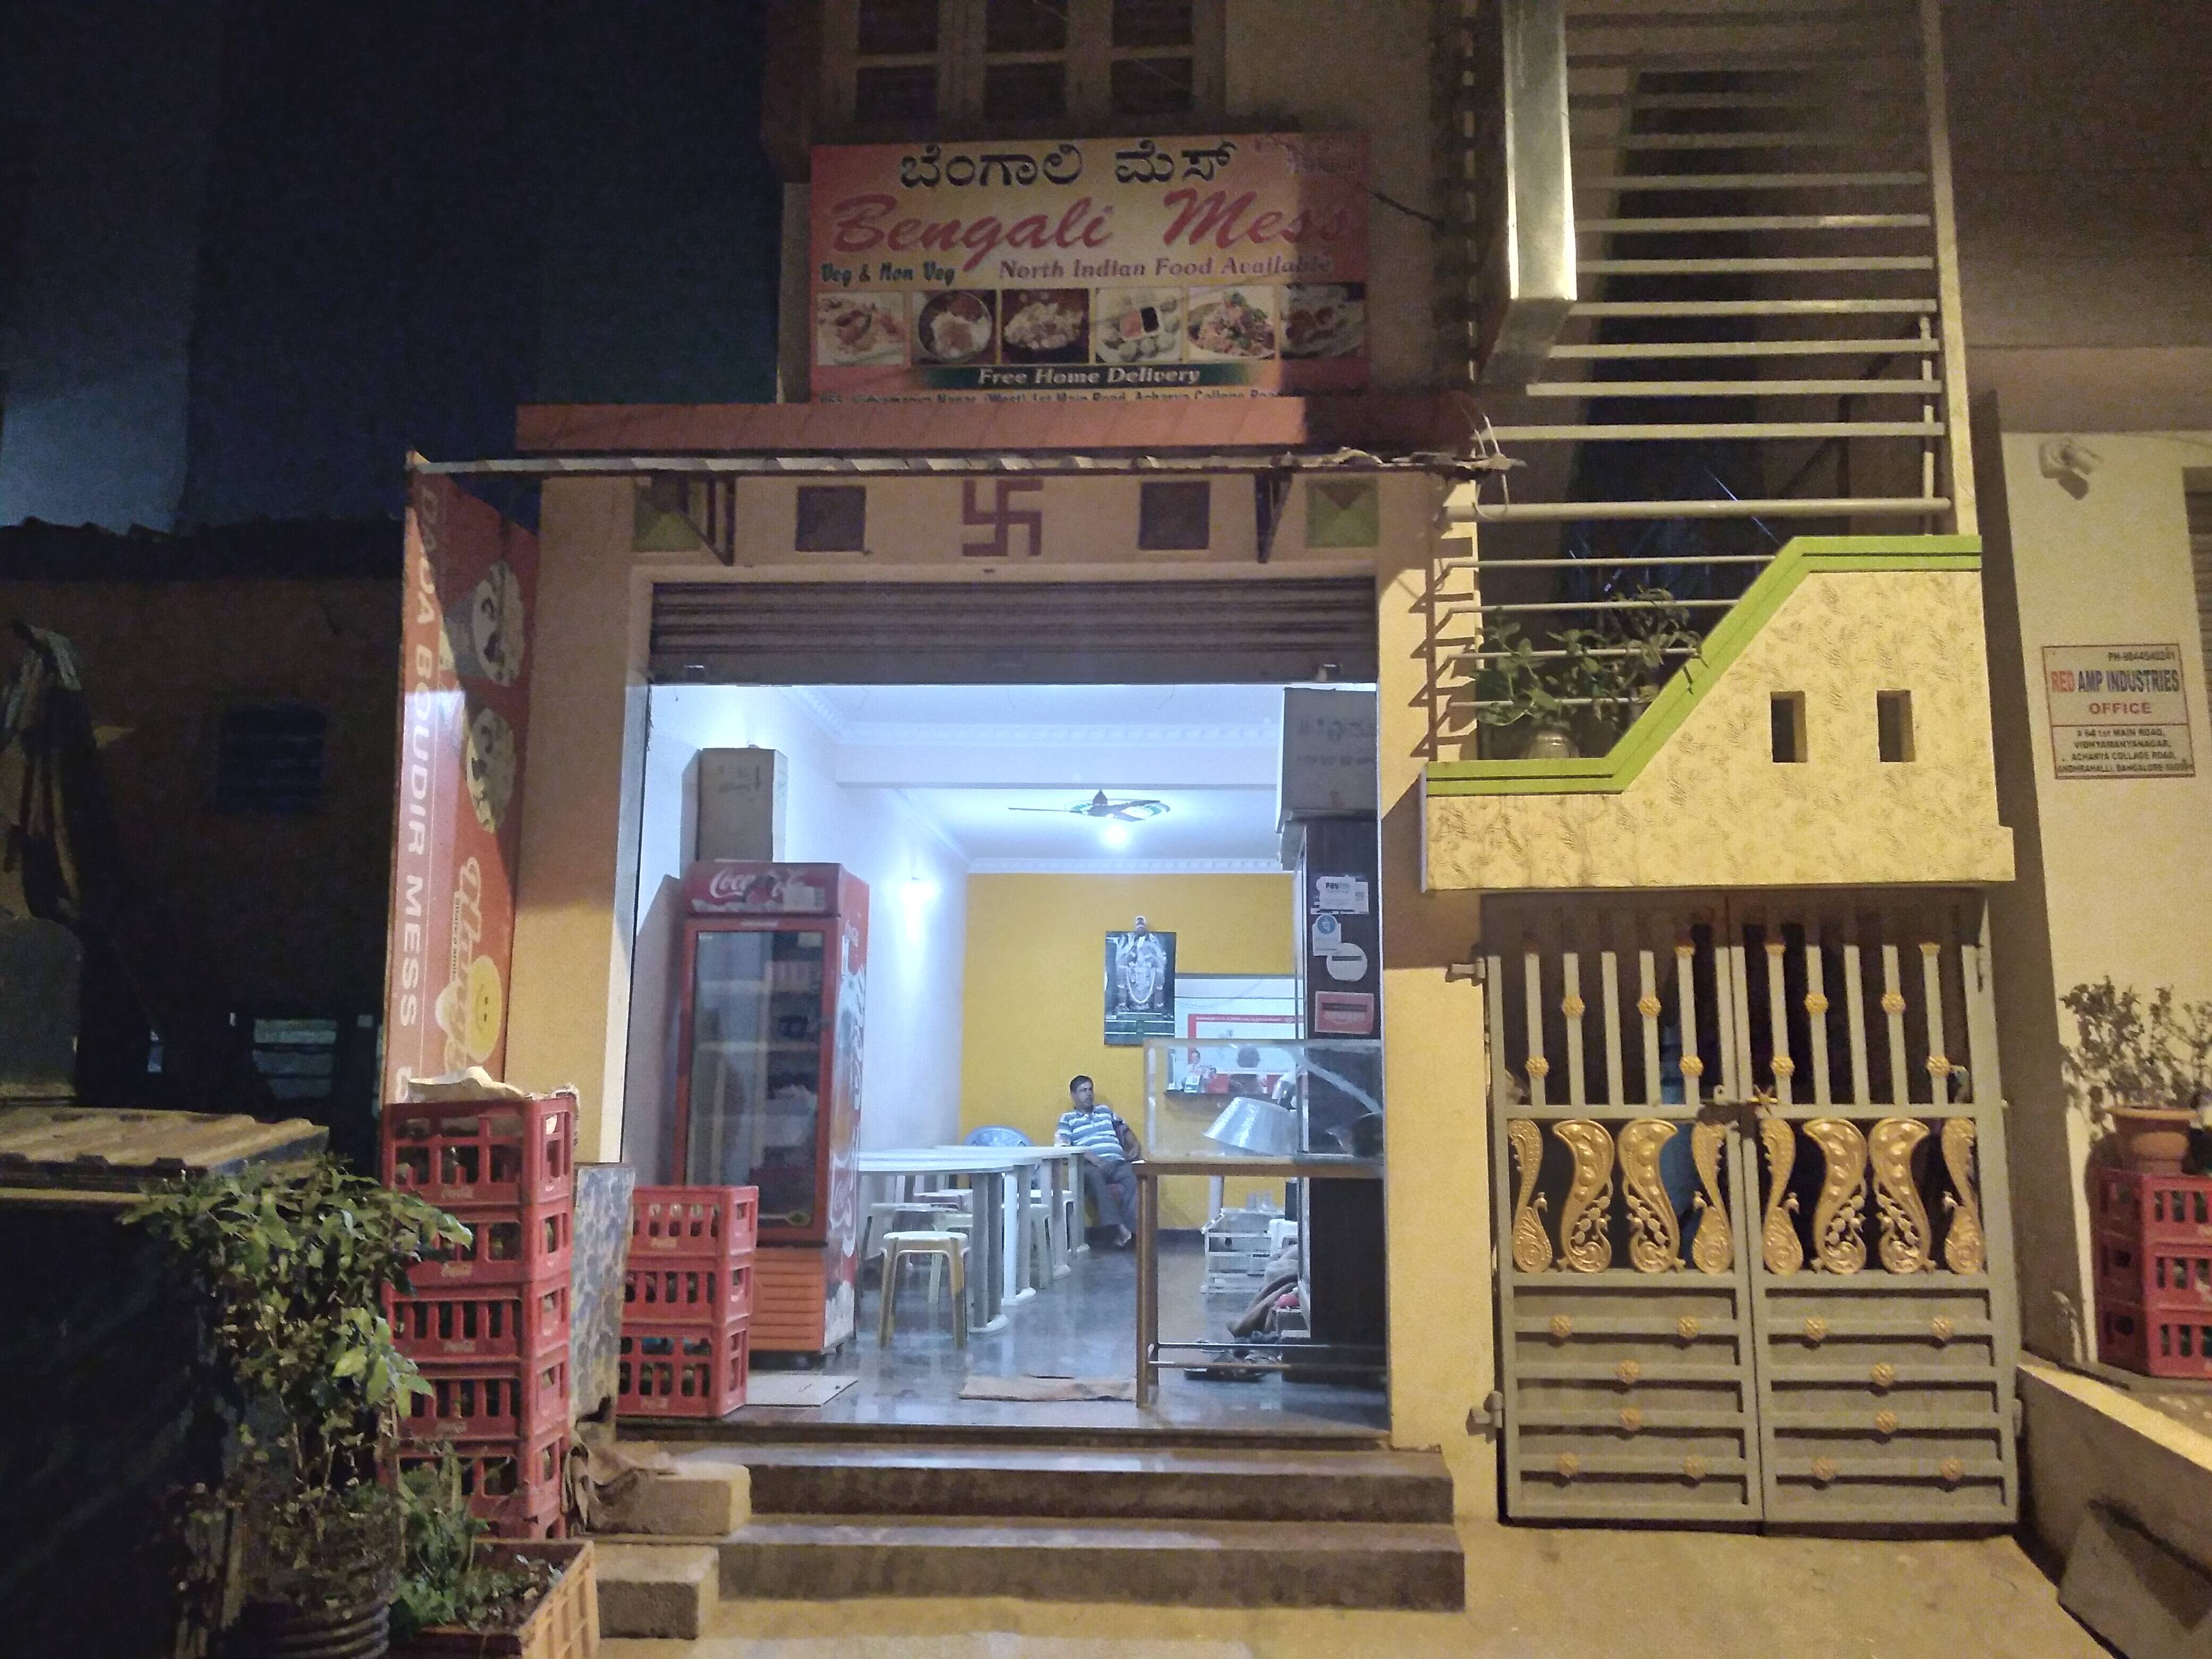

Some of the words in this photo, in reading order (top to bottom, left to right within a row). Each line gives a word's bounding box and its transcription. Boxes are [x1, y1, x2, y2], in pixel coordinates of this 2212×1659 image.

[901, 144, 1083, 188] ಬೆಂಗಾಲಿ
[1116, 139, 1237, 183] ಮೆಸ್
[833, 194, 1114, 272] Bengali
[1163, 187, 1348, 249] Mess
[822, 262, 851, 287] Veg
[858, 264, 870, 282] &
[880, 261, 914, 281] Non
[923, 261, 956, 286] Veg
[999, 259, 1064, 279] North
[1073, 258, 1145, 278] Indian
[1154, 257, 1212, 276] Food
[1221, 255, 1330, 275] Available
[978, 367, 1027, 385] Free
[1034, 367, 1101, 384] Home
[1107, 365, 1202, 385] Delivery
[417, 488, 438, 623] DADA
[2051, 669, 2074, 692] RED
[2077, 669, 2103, 692] AMP
[2106, 669, 2180, 692] INDUSTRIES
[2089, 702, 2152, 714] OFFICE
[408, 645, 432, 854] BOUDIR
[2072, 752, 2109, 761] ACHARYA
[2112, 751, 2149, 760] COLLAGE
[400, 875, 423, 1027] MESS
